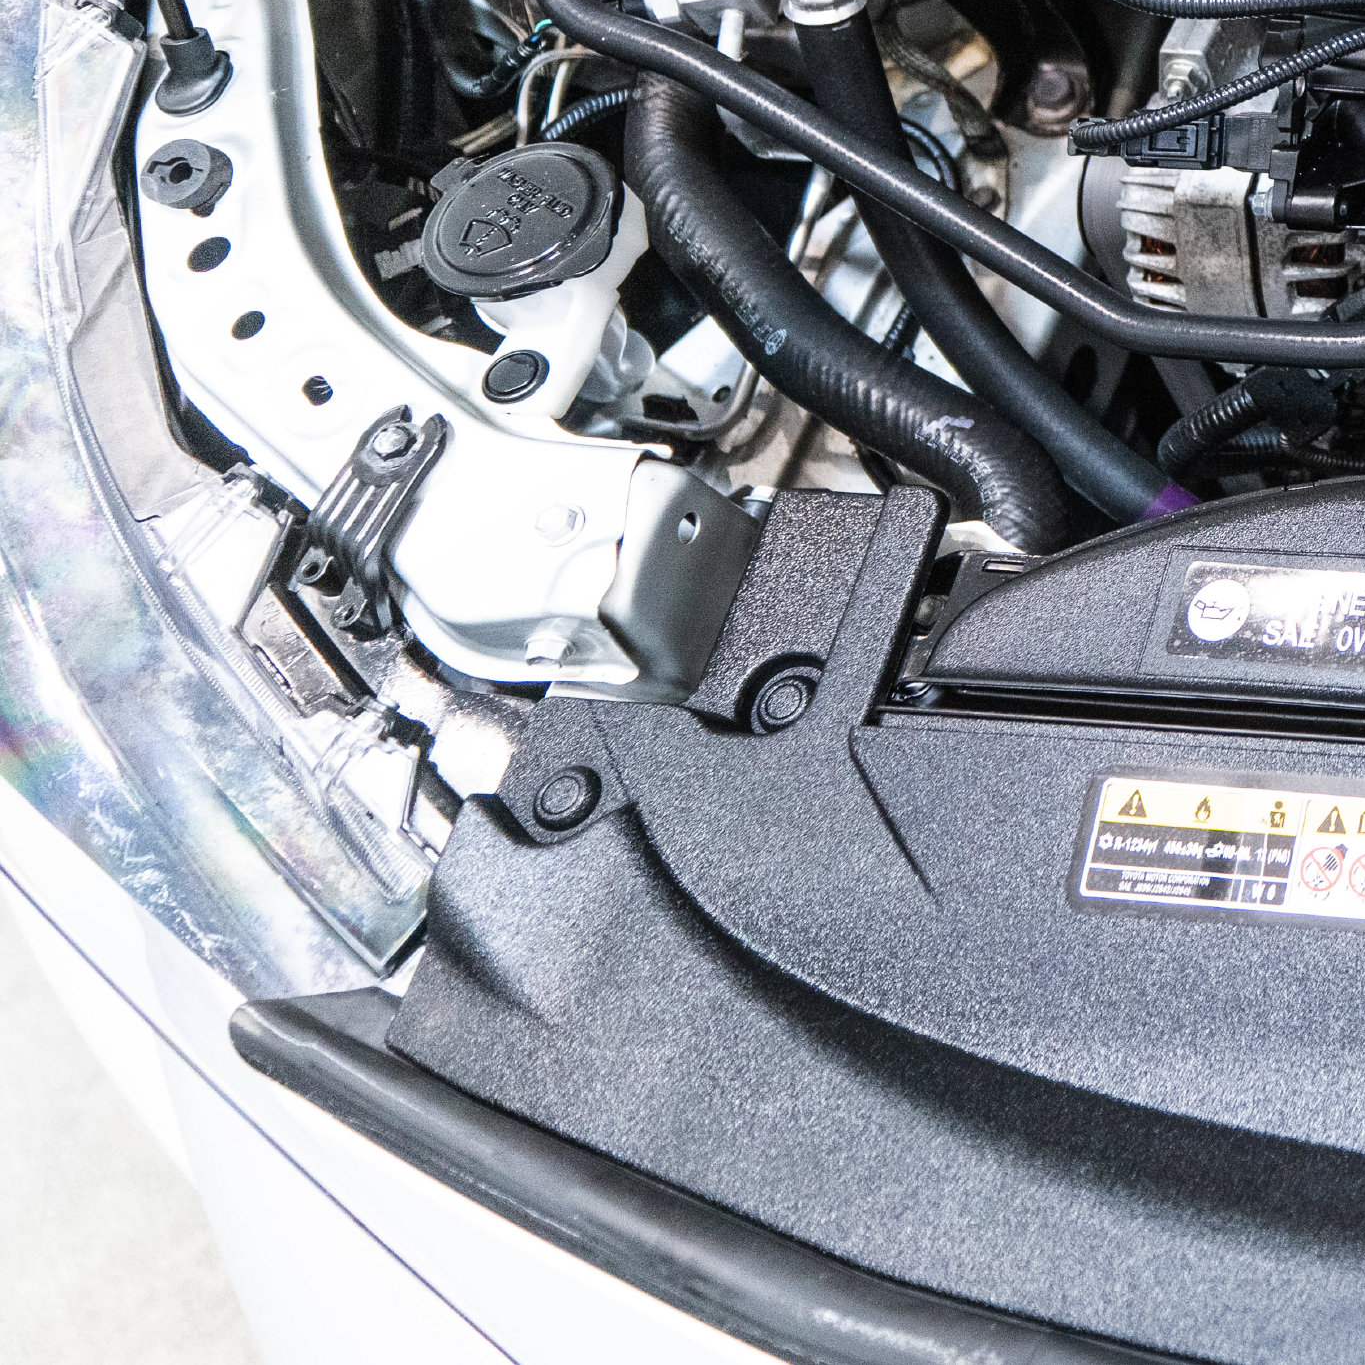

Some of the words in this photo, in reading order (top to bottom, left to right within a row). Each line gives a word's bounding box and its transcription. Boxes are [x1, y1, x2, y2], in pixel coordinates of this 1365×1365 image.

[1262, 620, 1318, 649] SAE
[1121, 871, 1145, 882] TOYOTA
[1145, 872, 1168, 884] MOTOR
